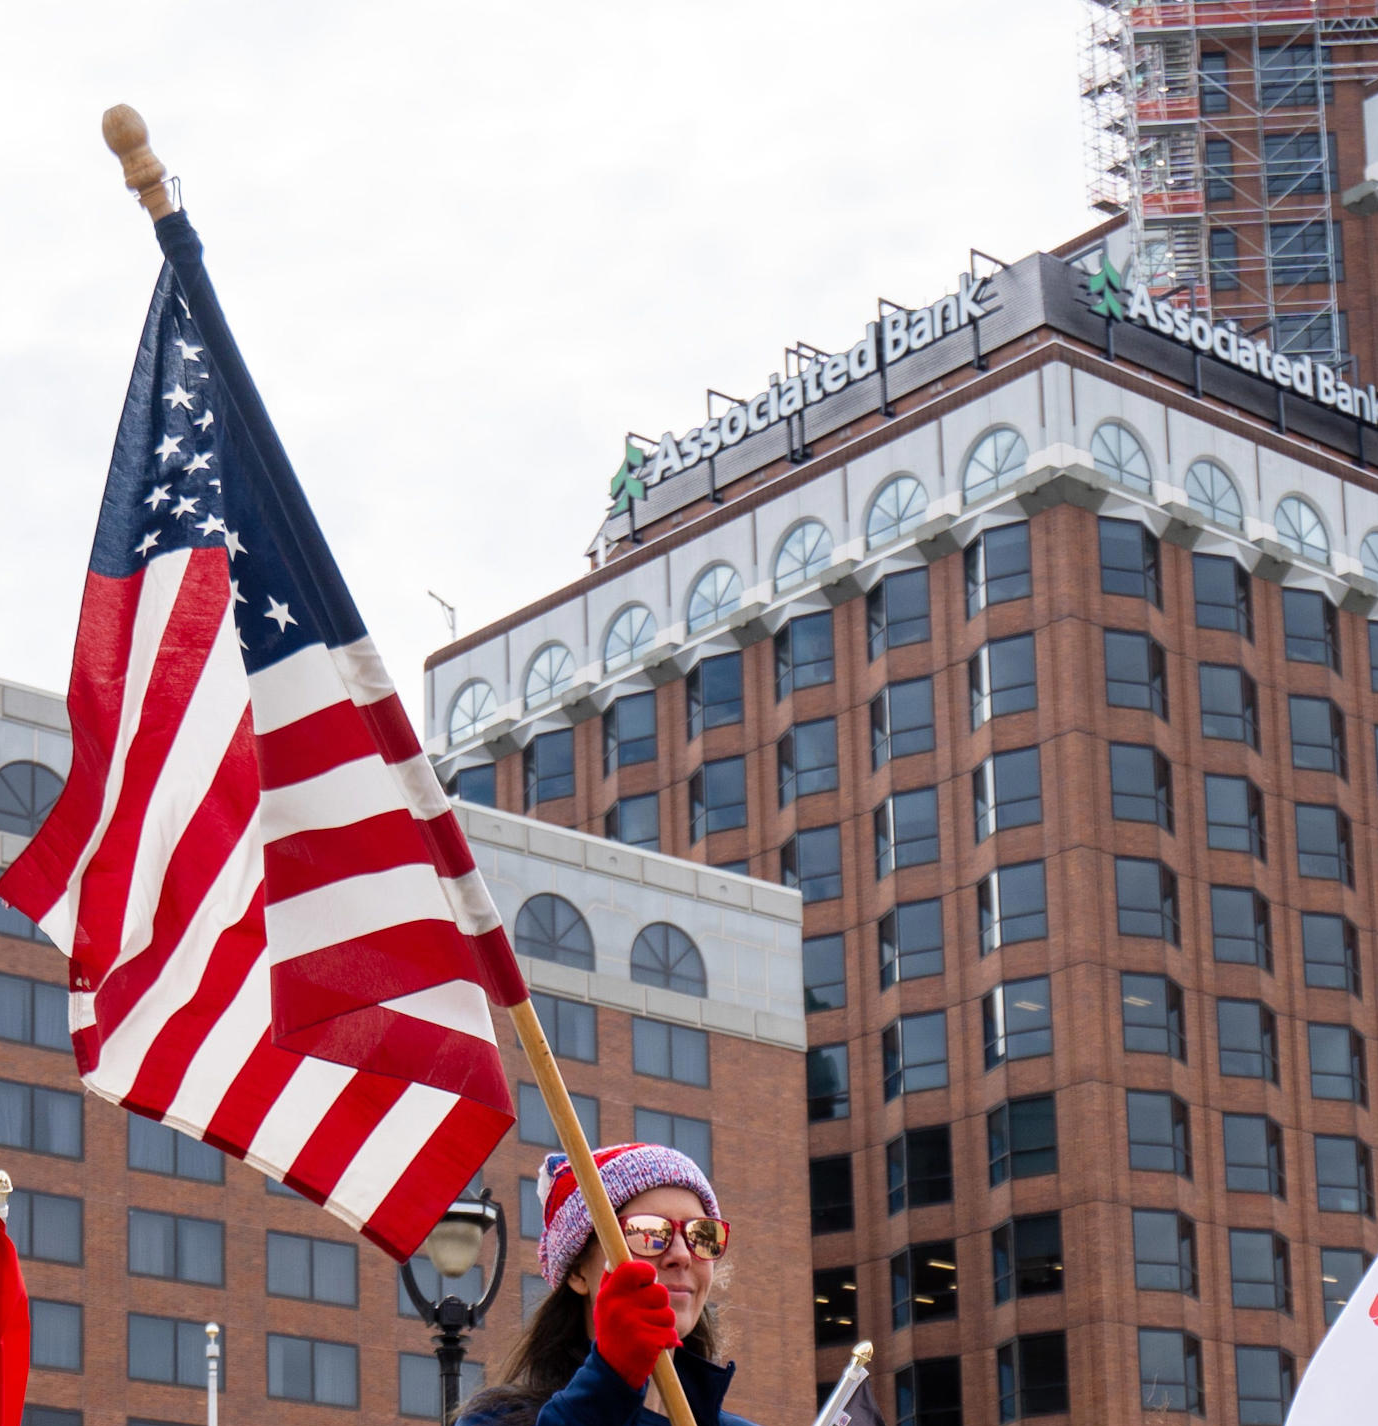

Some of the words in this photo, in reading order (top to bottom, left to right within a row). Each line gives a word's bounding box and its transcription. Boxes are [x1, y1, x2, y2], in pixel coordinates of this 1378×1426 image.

[651, 321, 879, 486] Associated
[881, 272, 988, 364] Bank
[1129, 282, 1314, 398] Associated
